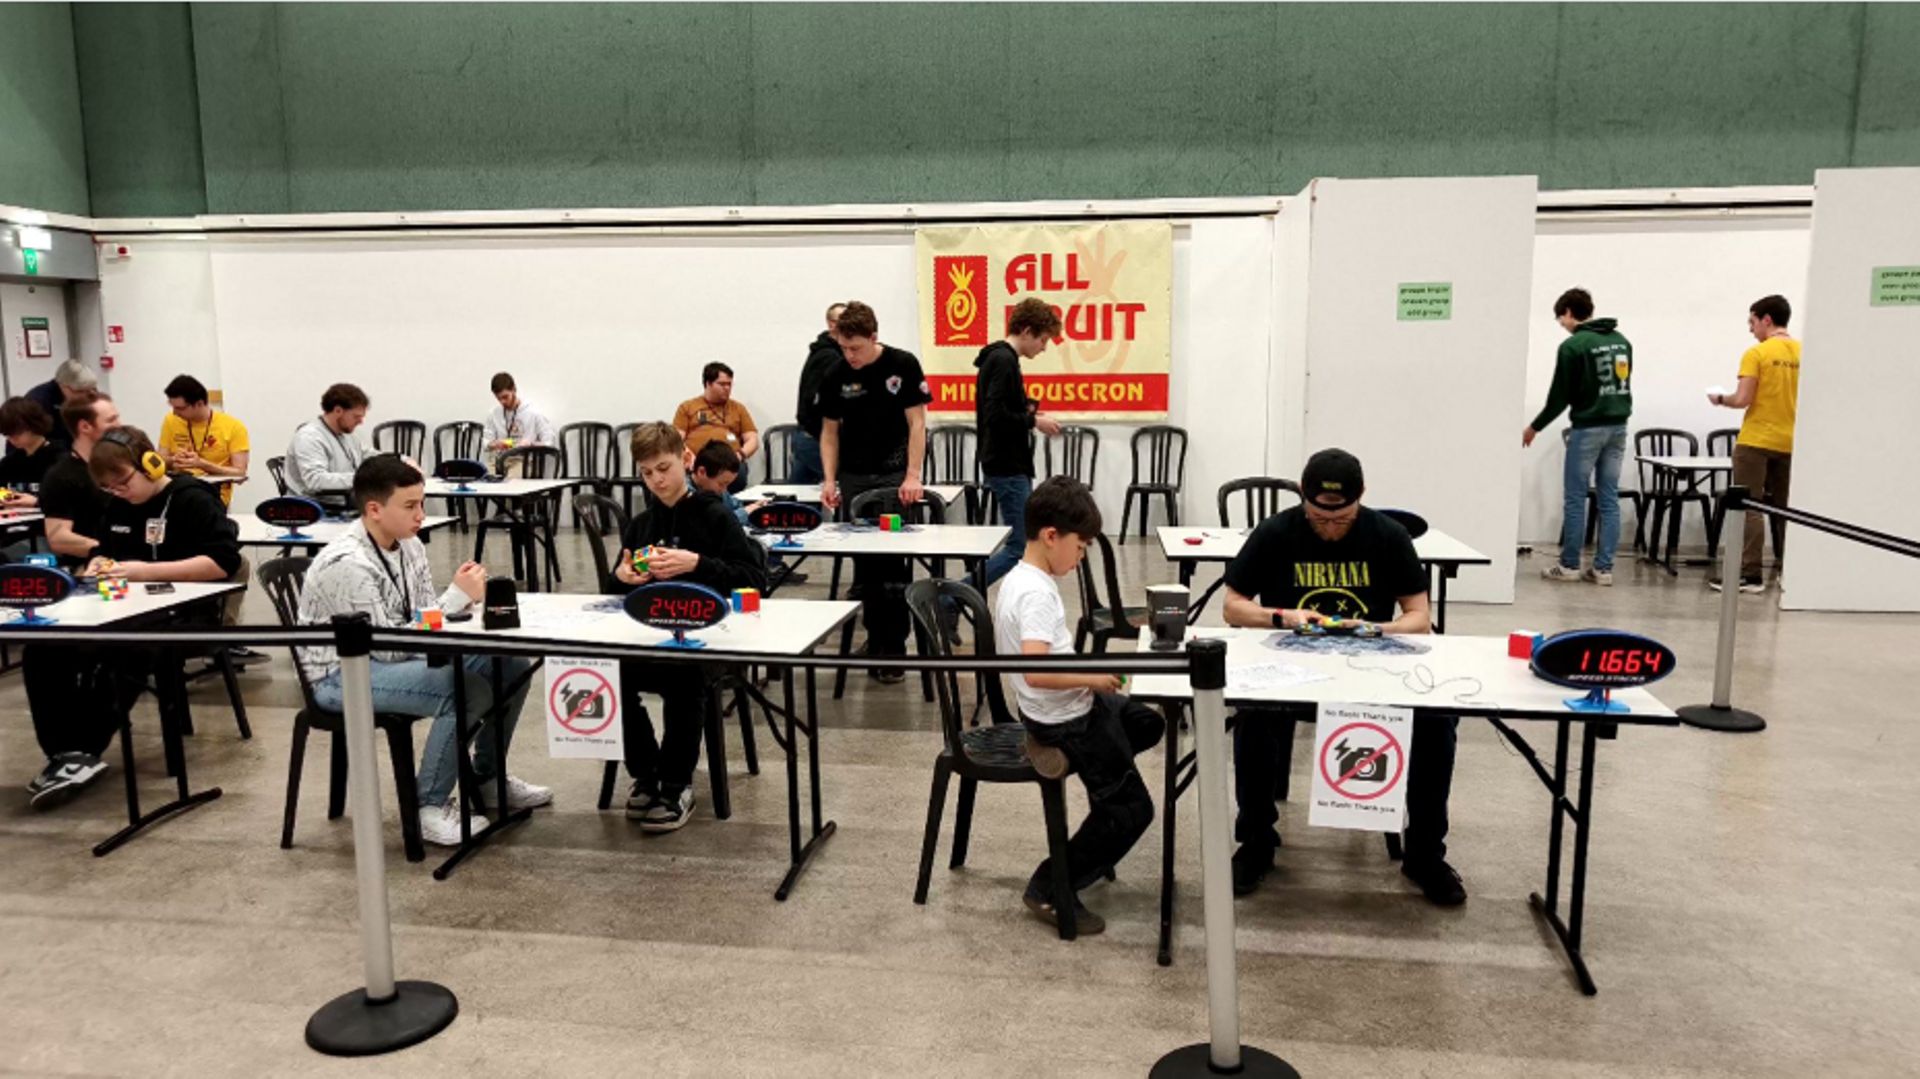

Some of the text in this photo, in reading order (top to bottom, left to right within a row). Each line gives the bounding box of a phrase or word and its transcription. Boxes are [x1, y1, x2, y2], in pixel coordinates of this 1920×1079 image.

[1004, 253, 1090, 295] ALL
[1025, 383, 1144, 403] OUSCRON
[1294, 561, 1370, 587] NIRVANA
[649, 598, 716, 619] 24.402
[1324, 709, 1337, 717] No
[1362, 712, 1387, 720] Thank
[1354, 803, 1378, 811] Thank
